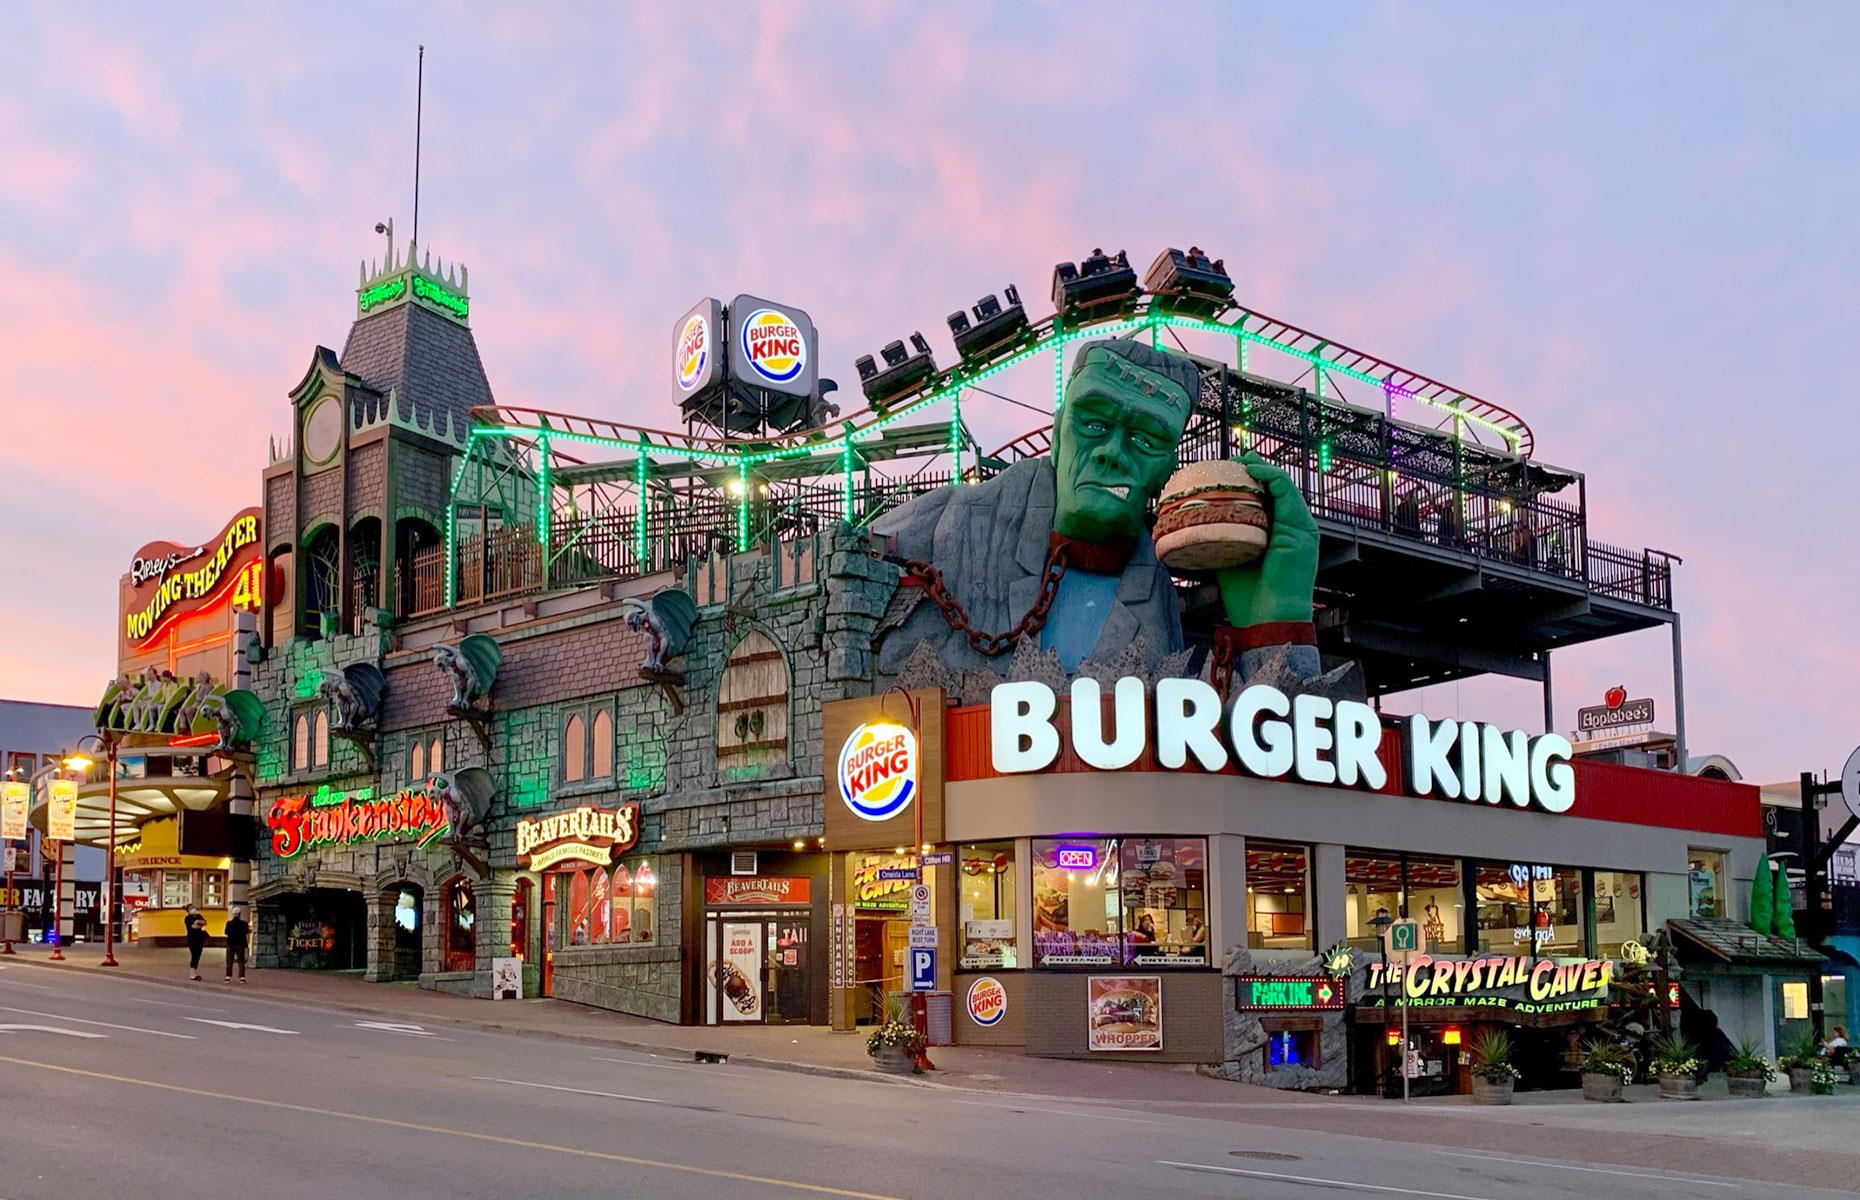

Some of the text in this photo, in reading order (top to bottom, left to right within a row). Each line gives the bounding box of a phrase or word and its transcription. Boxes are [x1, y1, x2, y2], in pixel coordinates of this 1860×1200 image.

[750, 325, 798, 341] BURGER
[752, 339, 800, 361] KING
[127, 515, 257, 639] MOVING THEATER
[1583, 705, 1648, 728] Applebee's
[847, 734, 906, 776] BURGER
[991, 676, 1576, 814] BURGER KING
[850, 750, 909, 799] KING
[1061, 851, 1090, 865] OPEN
[881, 870, 915, 879] Oneida Lane
[288, 937, 333, 951] TICKETS
[916, 952, 930, 978] P
[1370, 954, 1614, 1001] THE CRYSTAL CAVES
[973, 987, 1001, 1003] BURGER
[1252, 982, 1312, 1005] PARKING
[974, 995, 1002, 1015] KING
[1464, 997, 1508, 1008] MAZE
[1514, 999, 1598, 1014] ADVENTURE
[1095, 1033, 1156, 1044] WHOPPER
